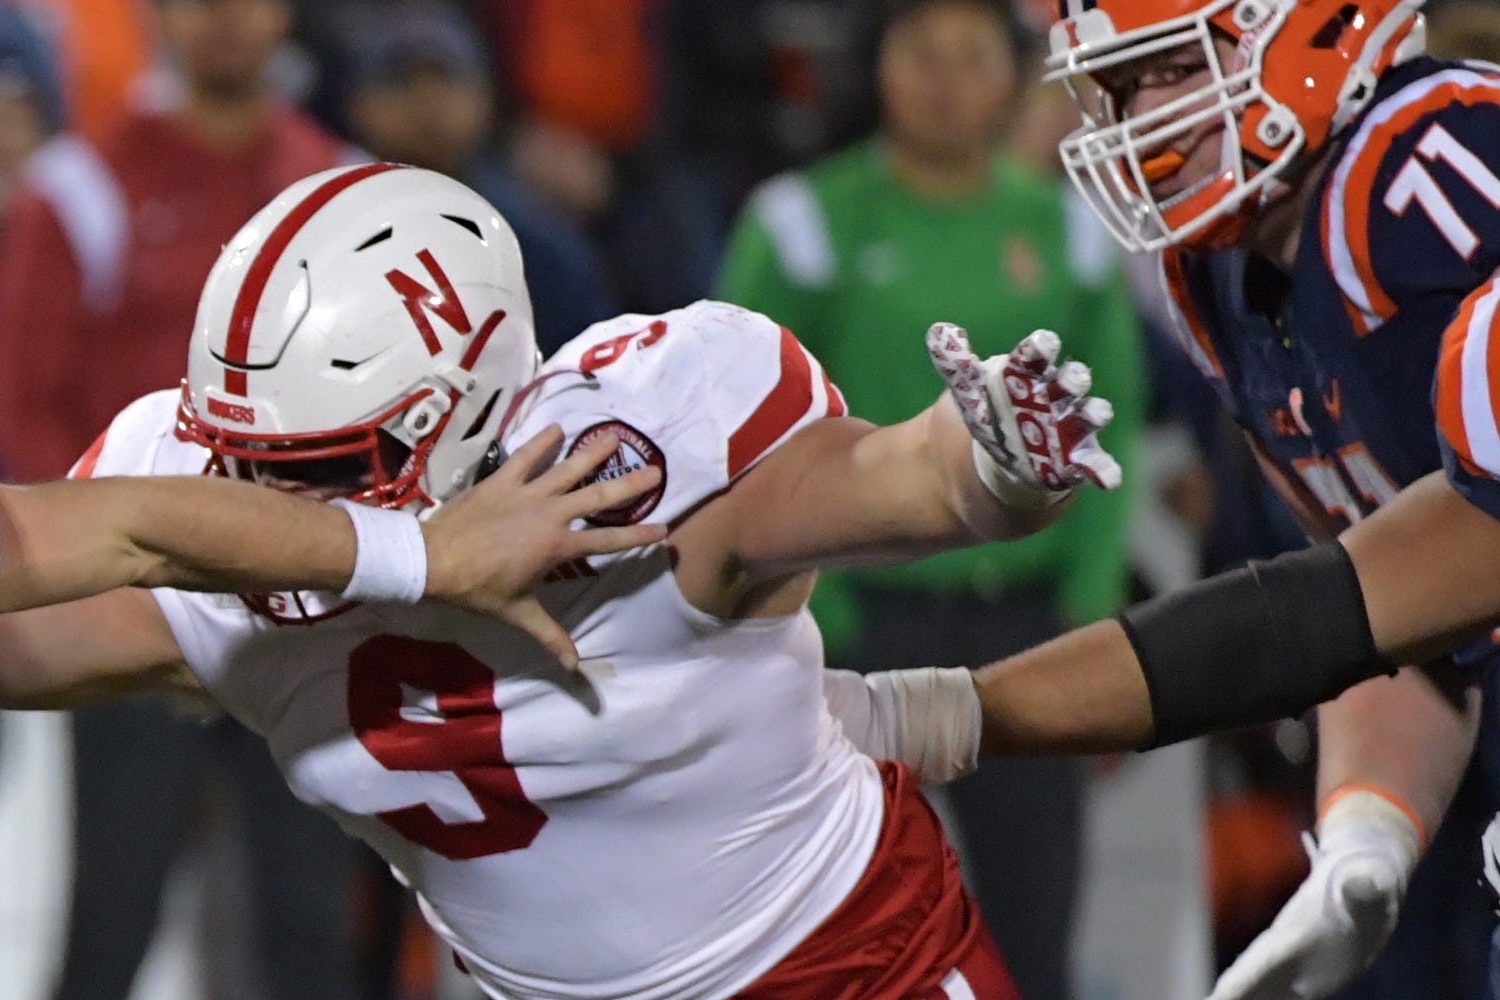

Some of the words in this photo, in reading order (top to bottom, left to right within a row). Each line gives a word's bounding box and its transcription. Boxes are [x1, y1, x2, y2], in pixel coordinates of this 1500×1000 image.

[1382, 121, 1500, 263] 71
[384, 247, 472, 357] N
[348, 633, 549, 861] 9
